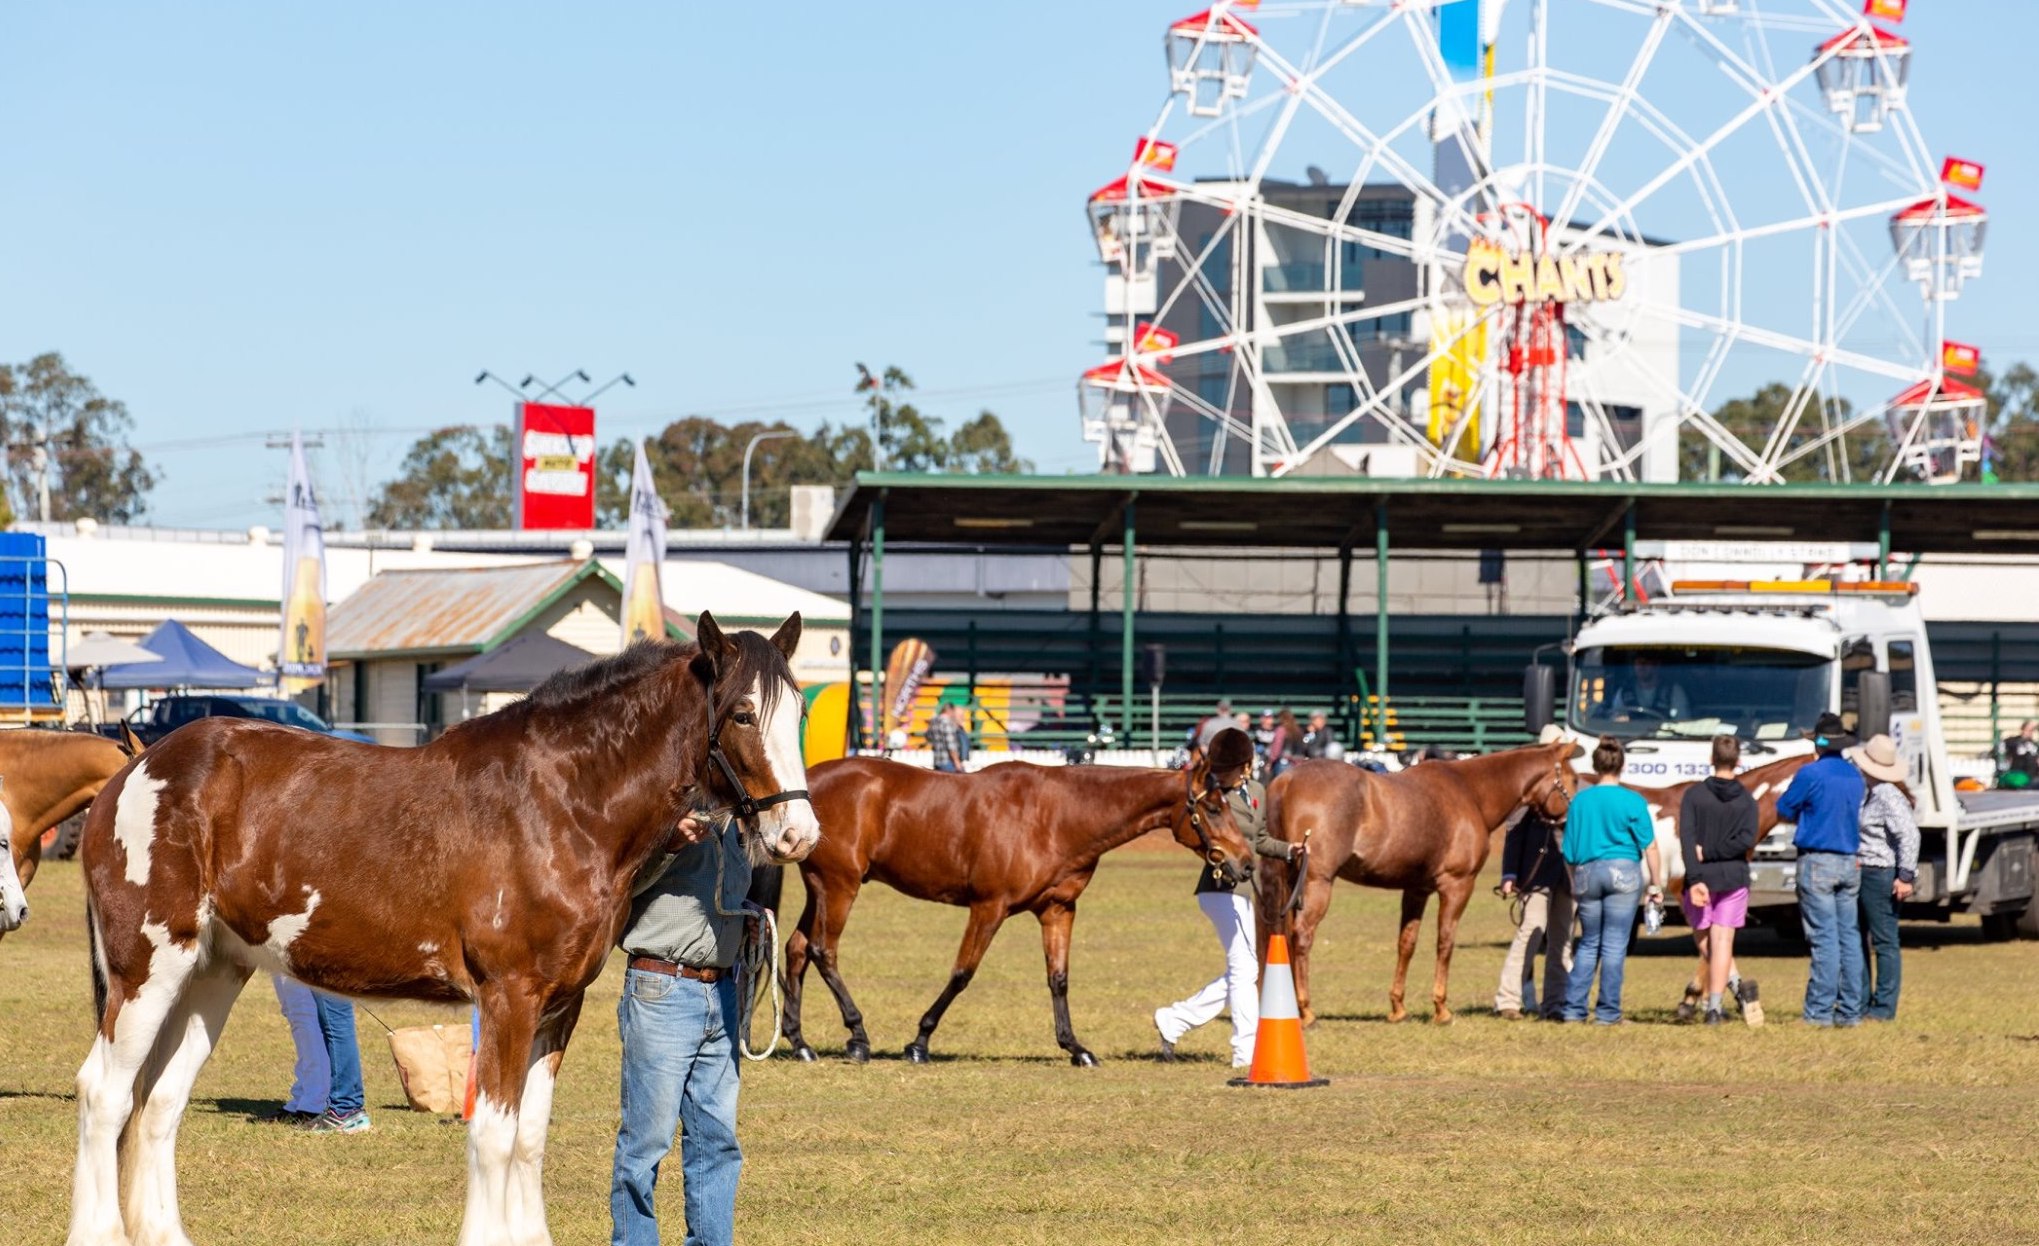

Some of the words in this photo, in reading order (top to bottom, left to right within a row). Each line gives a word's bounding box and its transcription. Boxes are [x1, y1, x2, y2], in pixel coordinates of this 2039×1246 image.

[1463, 238, 1625, 303] CHANTS
[1621, 763, 1667, 775] 300
[1674, 764, 1711, 776] 133
